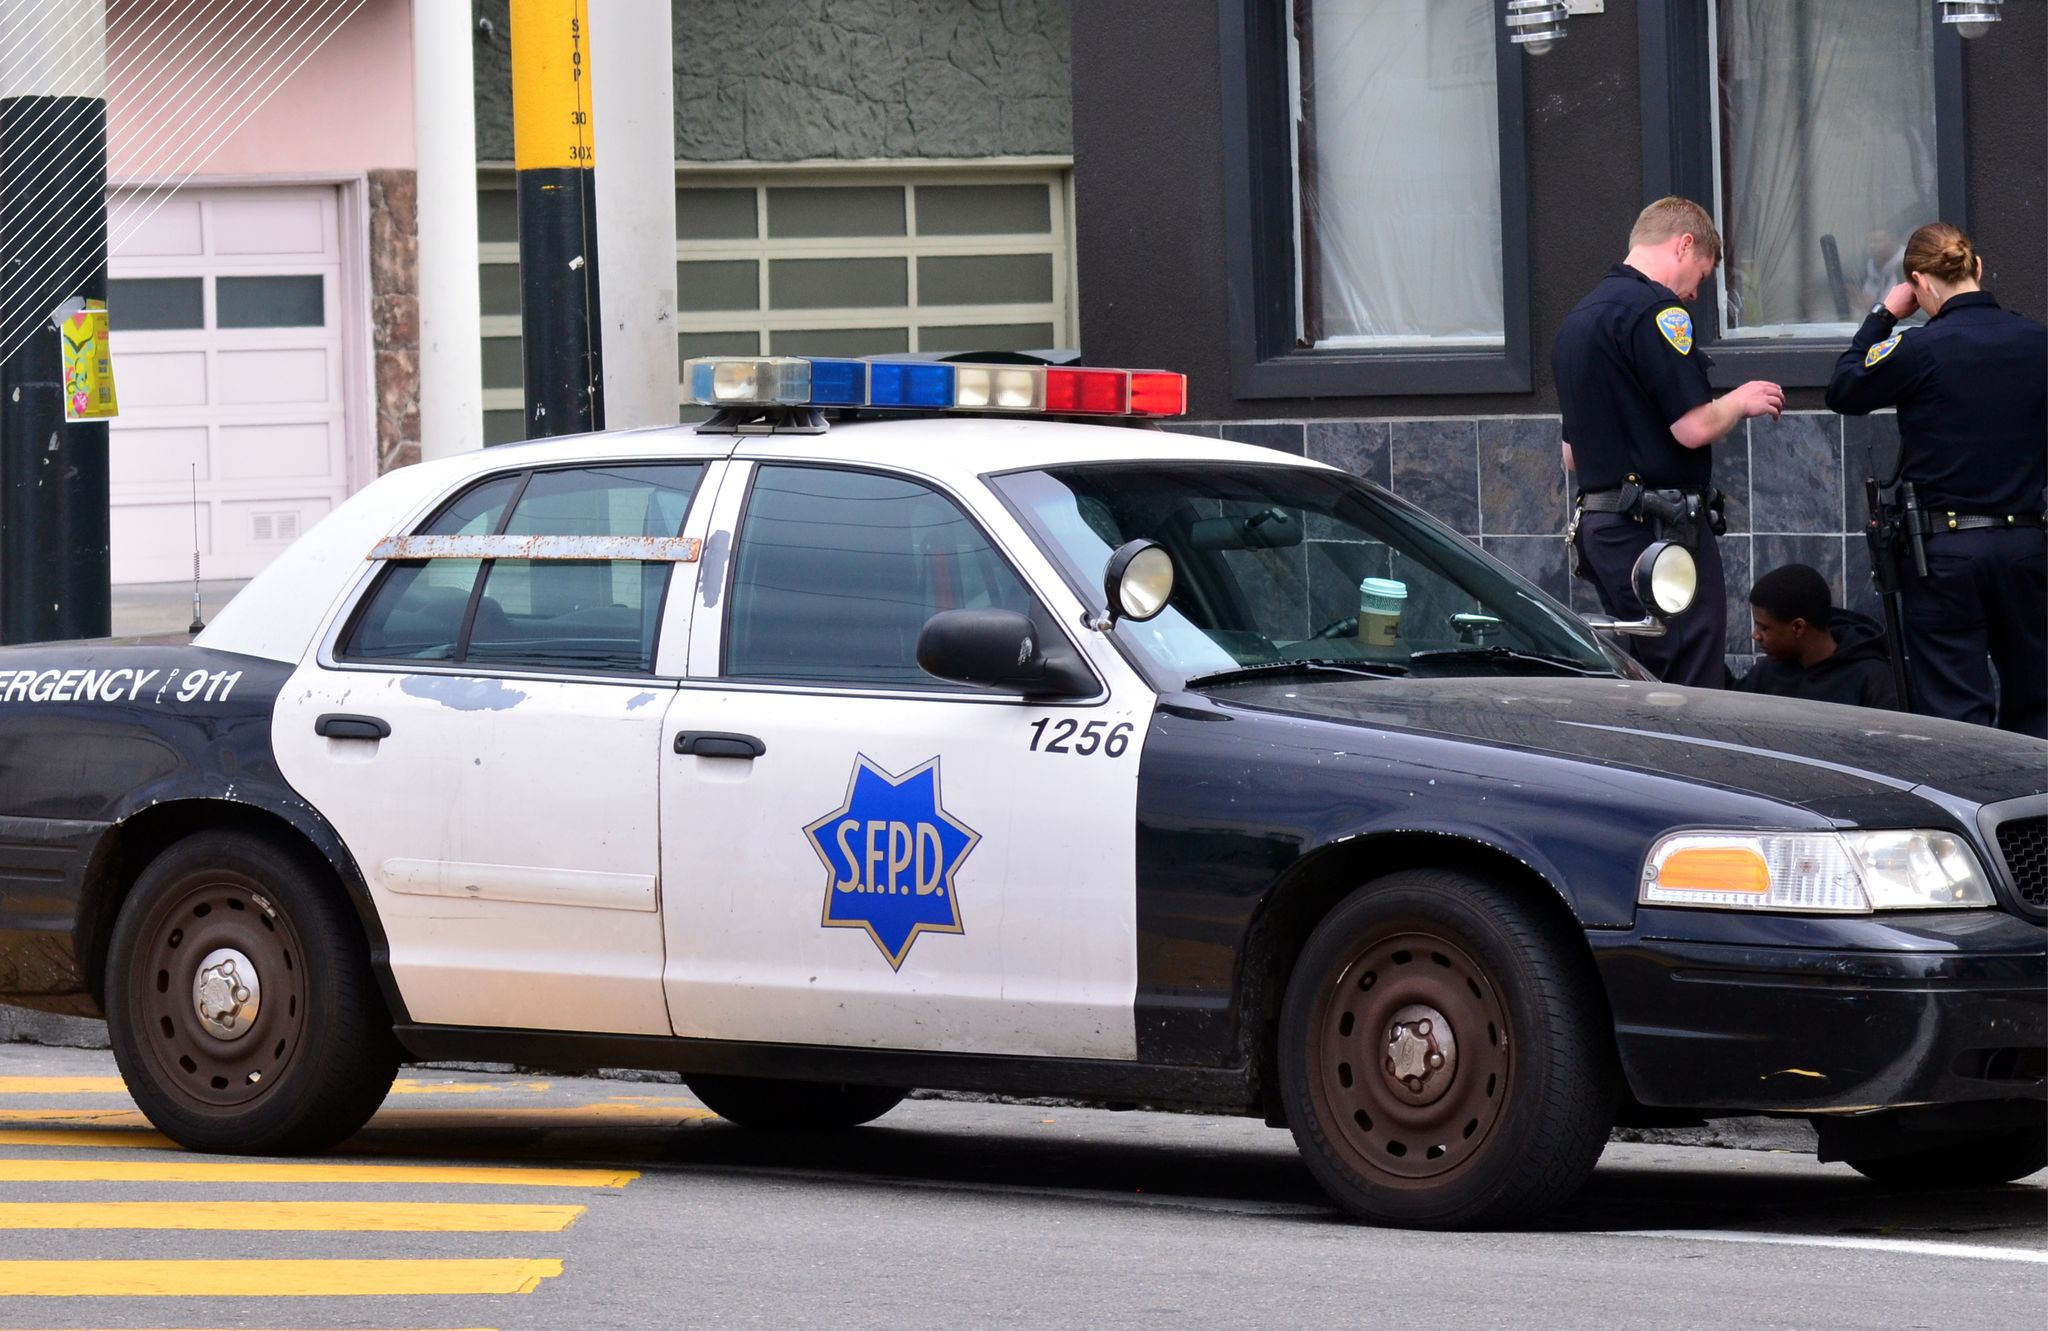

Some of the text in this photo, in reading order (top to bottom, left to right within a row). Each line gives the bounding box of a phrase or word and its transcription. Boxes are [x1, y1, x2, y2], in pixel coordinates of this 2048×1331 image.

[571, 18, 581, 82] STOP
[571, 112, 586, 125] 30
[569, 146, 592, 160] 30X
[156, 668, 180, 704] DIAL
[176, 669, 244, 702] 911
[1029, 717, 1134, 758] 1256
[836, 819, 944, 897] S.F.P.D.
